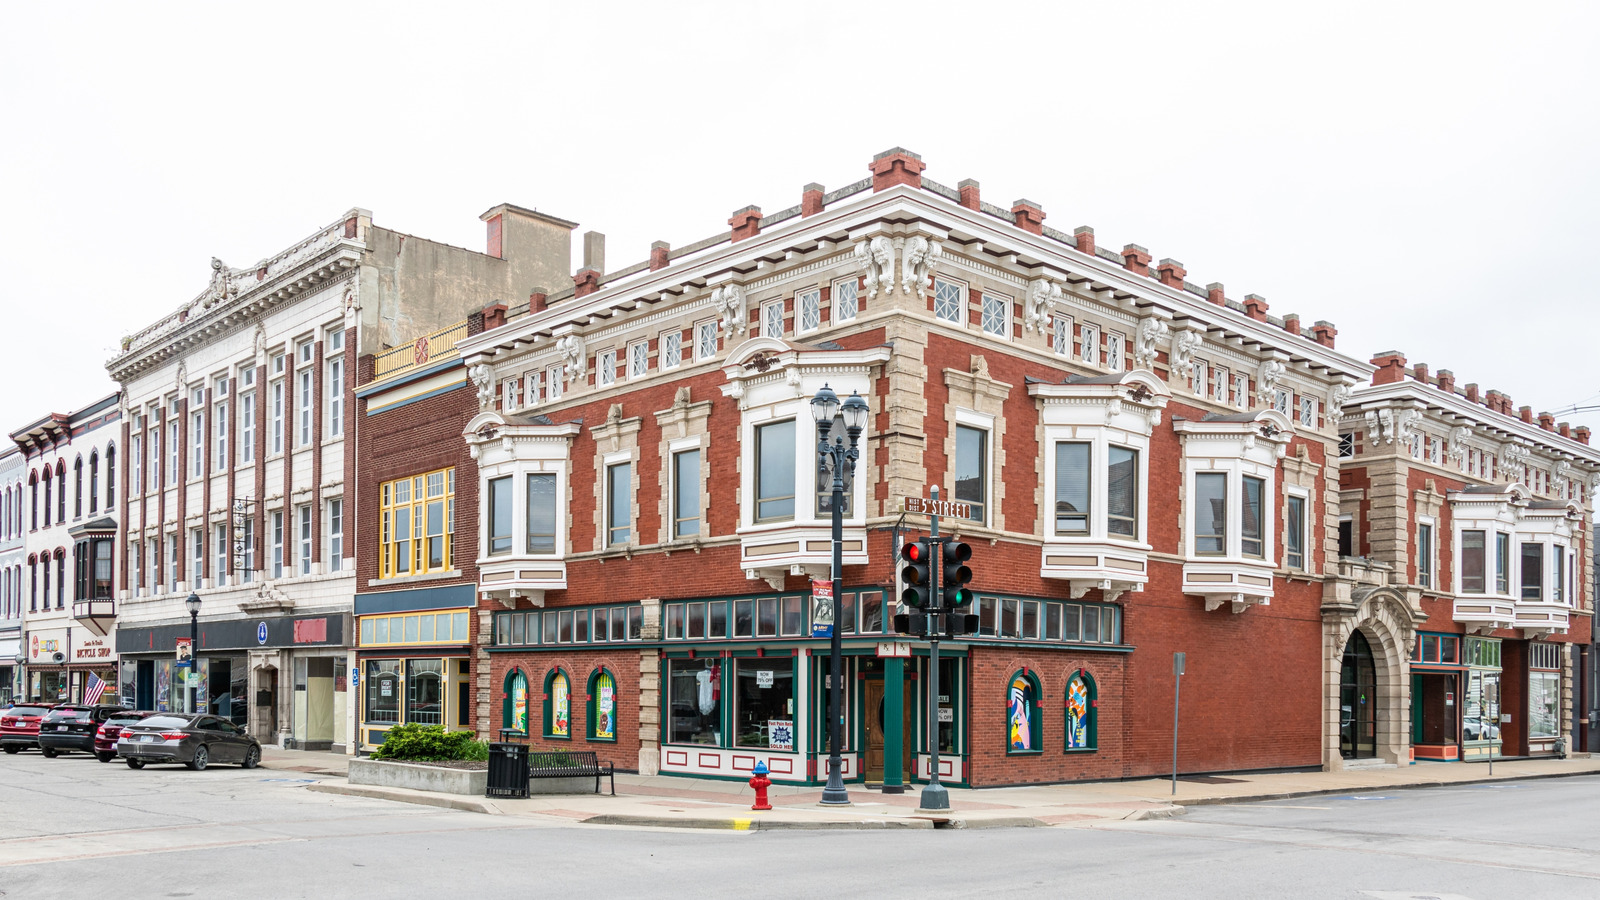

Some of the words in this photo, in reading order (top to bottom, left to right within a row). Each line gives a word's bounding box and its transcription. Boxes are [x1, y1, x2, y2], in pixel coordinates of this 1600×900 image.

[932, 500, 966, 518] STREET
[77, 648, 96, 658] BICYCLE
[98, 648, 111, 657] SHOP
